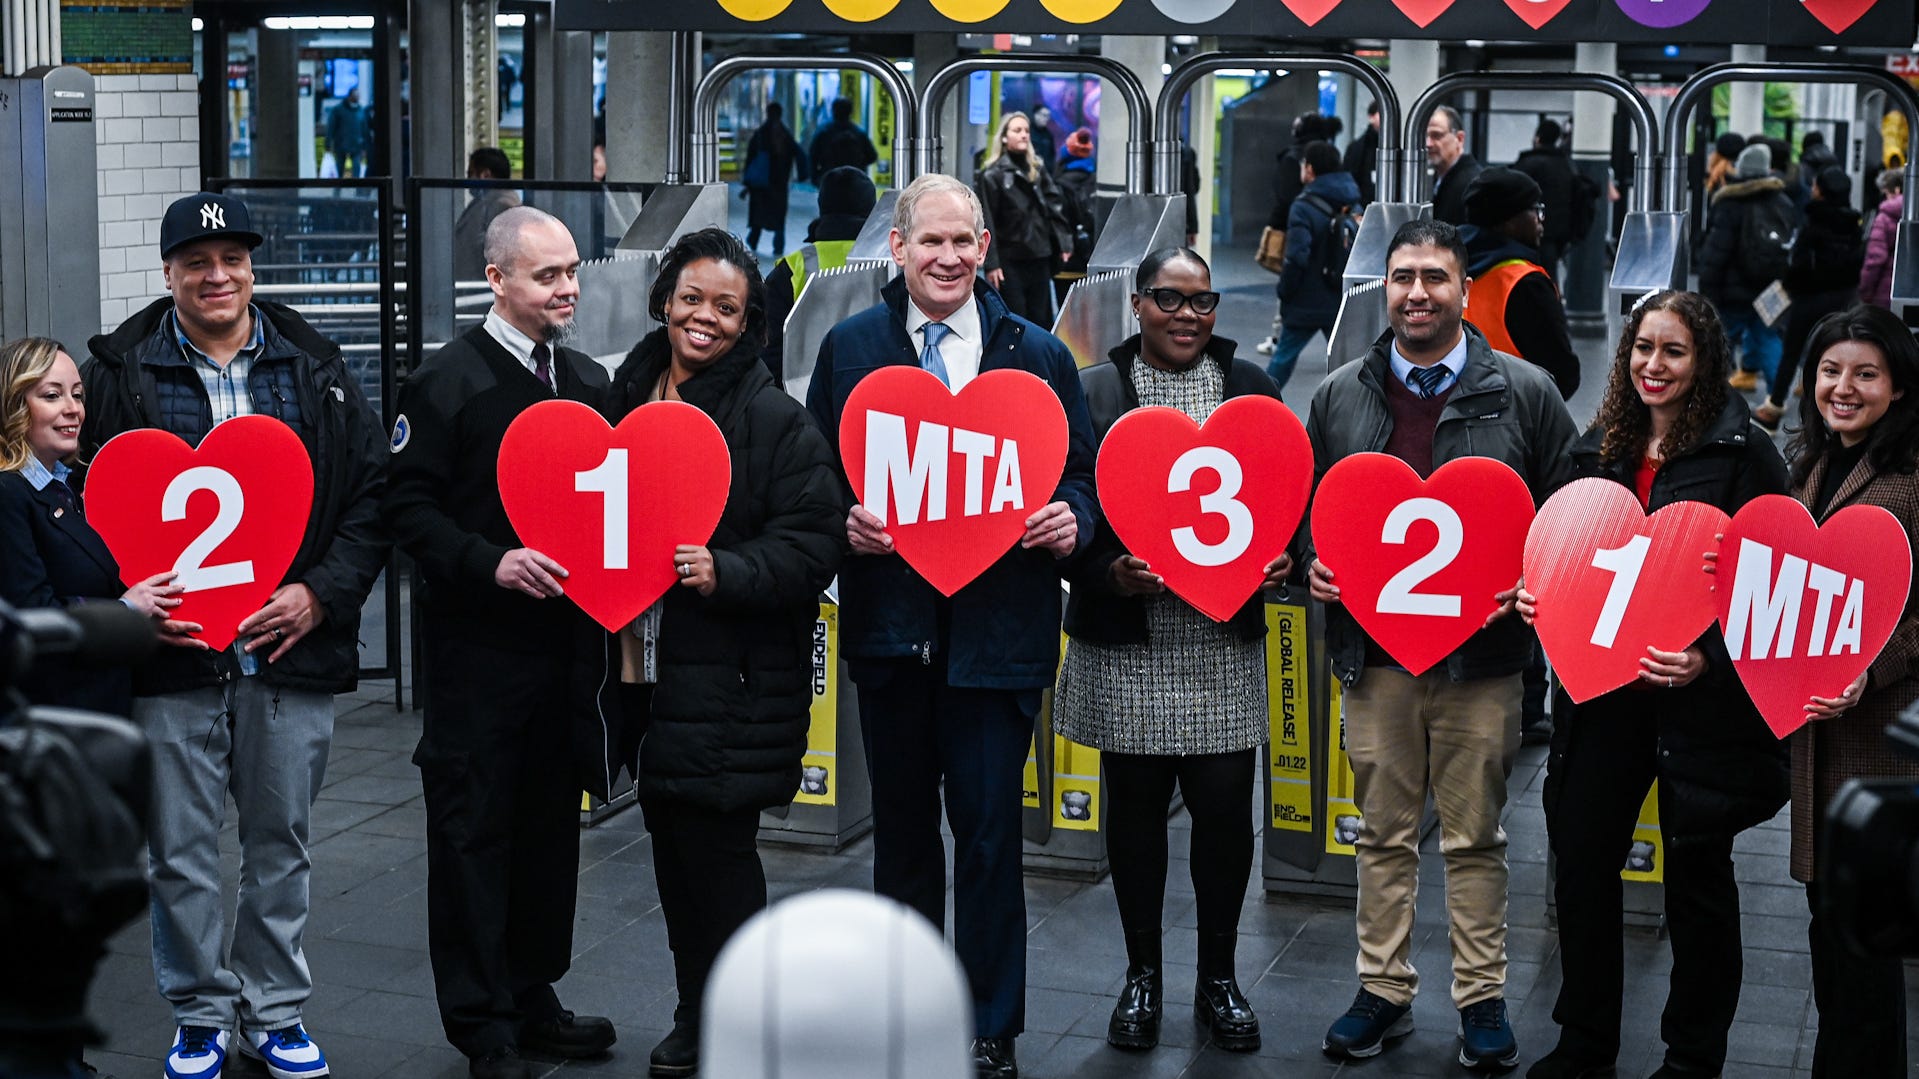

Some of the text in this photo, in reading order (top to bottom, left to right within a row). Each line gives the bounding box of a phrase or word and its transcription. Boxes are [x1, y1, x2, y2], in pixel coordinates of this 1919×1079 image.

[200, 202, 226, 229] NY
[575, 448, 628, 570] 1
[864, 409, 1024, 527] MTA
[1167, 446, 1254, 567] 3
[161, 466, 255, 593] 2
[1376, 497, 1464, 617] 2
[1590, 534, 1651, 648] 1
[1724, 538, 1863, 661] MTA
[814, 622, 826, 695] ENDFIELD
[1274, 804, 1295, 813] END
[1274, 811, 1303, 822] FIELD
